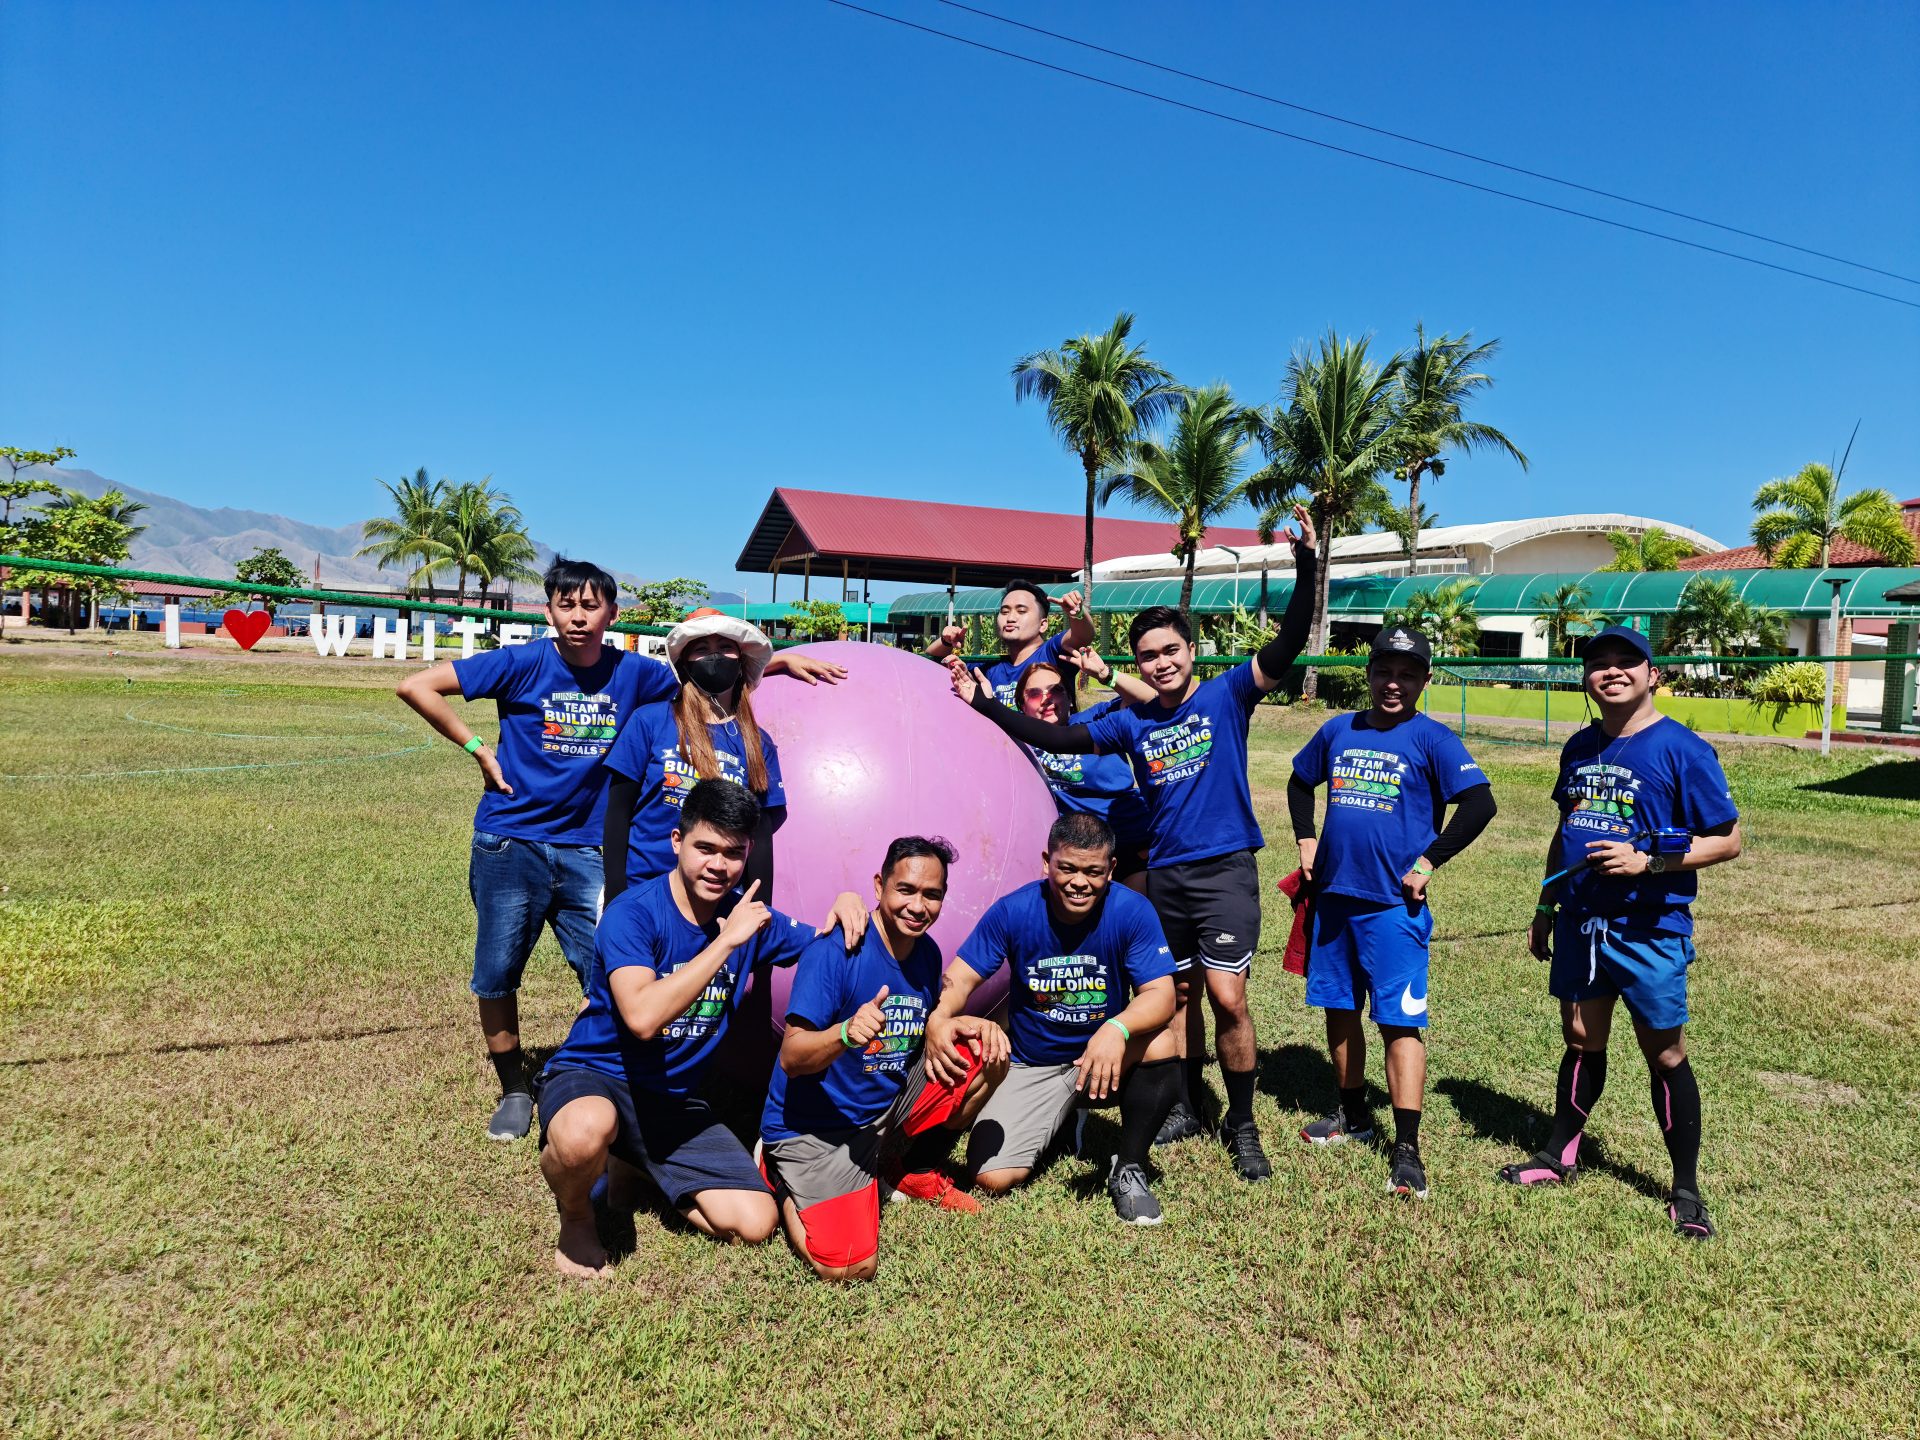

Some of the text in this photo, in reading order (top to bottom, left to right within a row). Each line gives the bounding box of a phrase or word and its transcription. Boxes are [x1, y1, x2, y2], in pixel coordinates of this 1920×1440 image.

[166, 604, 181, 649] I
[564, 702, 598, 713] TEAM
[545, 710, 616, 726] BUILDING
[1162, 726, 1191, 745] TEAM
[561, 745, 598, 755] GOALS
[1145, 729, 1211, 761] BUILDING
[1352, 758, 1384, 770] TEAM
[664, 760, 743, 786] BUILNG
[1167, 765, 1199, 781] GOALS
[1333, 766, 1401, 785] BUILDING
[1340, 796, 1375, 808] GOALS
[1573, 817, 1609, 831] GOALS
[1610, 825, 1629, 834] 22
[1051, 967, 1083, 979] TEAM
[1029, 977, 1106, 992] BUILDING
[1049, 1008, 1088, 1023] GOALS
